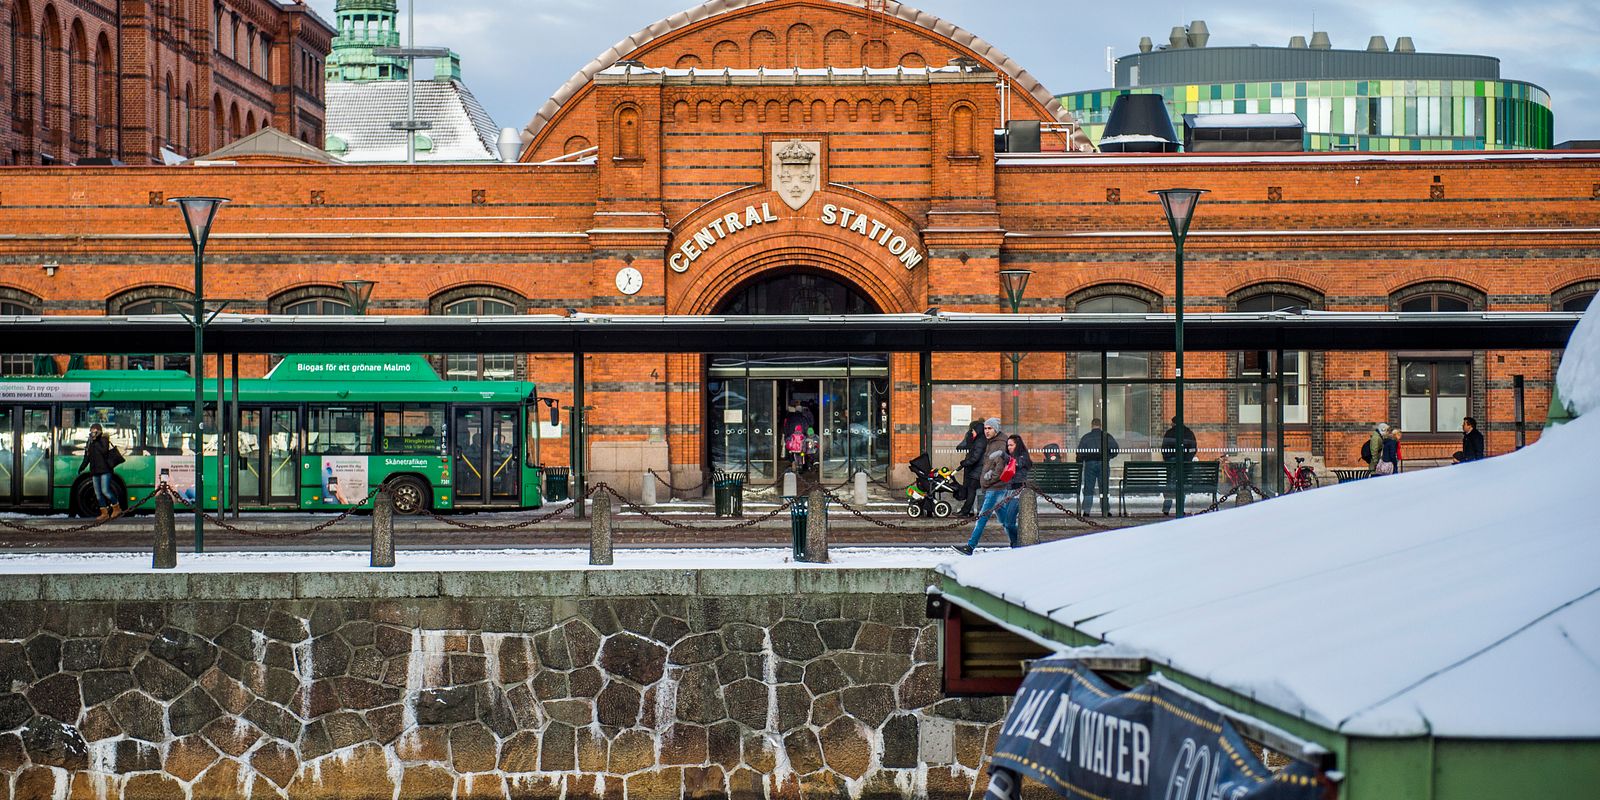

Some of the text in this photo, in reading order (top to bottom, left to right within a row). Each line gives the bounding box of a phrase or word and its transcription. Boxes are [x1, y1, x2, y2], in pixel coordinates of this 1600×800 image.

[669, 203, 923, 273] CENTRAL STATION
[297, 363, 324, 372] Biogas
[326, 363, 336, 371] för
[352, 363, 381, 372] grönare
[384, 363, 411, 371] Malmö
[650, 368, 659, 380] 4
[384, 438, 389, 449] 3
[385, 458, 428, 466] Skånetrafiken
[1079, 708, 1151, 786] WATER
